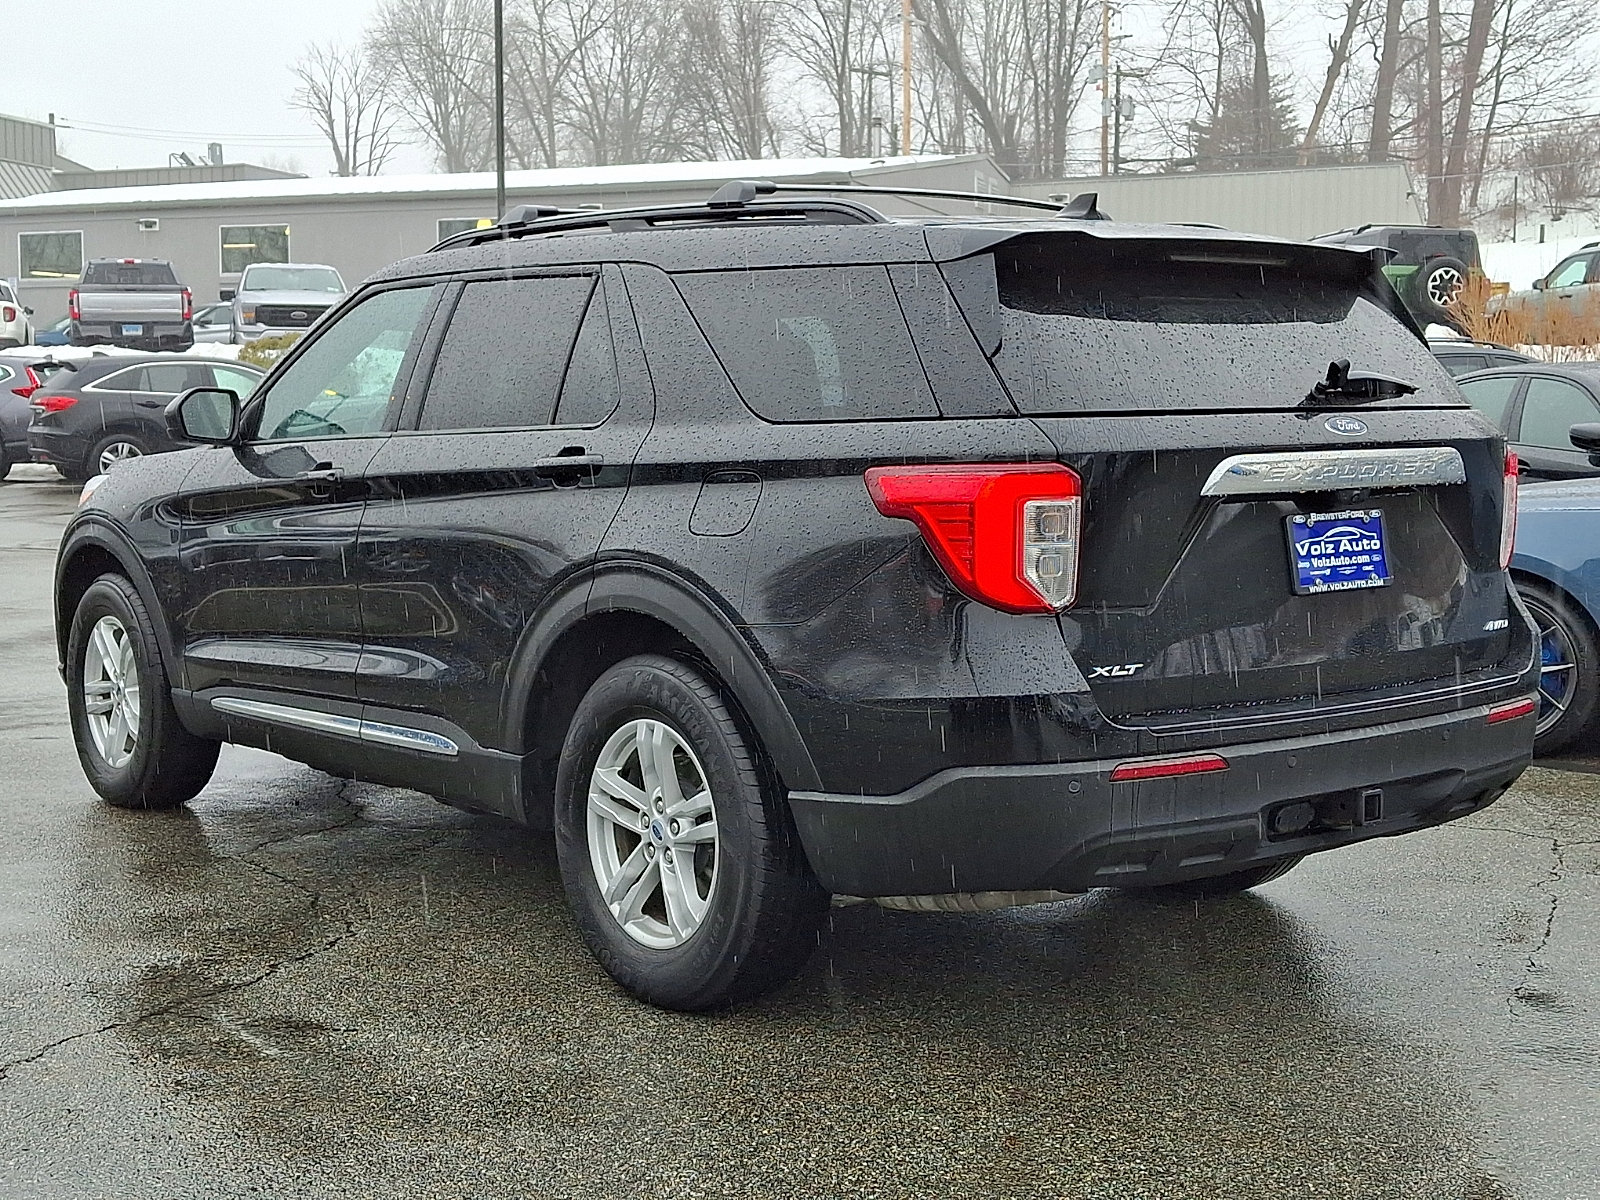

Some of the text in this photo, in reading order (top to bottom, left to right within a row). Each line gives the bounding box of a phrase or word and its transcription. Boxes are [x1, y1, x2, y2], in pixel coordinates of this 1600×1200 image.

[1336, 419, 1361, 430] Ford
[1262, 462, 1437, 482] EXPLORER
[1295, 539, 1381, 556] Volz Auto
[1311, 555, 1371, 568] VolzAuto.com
[1087, 663, 1144, 679] XLT
